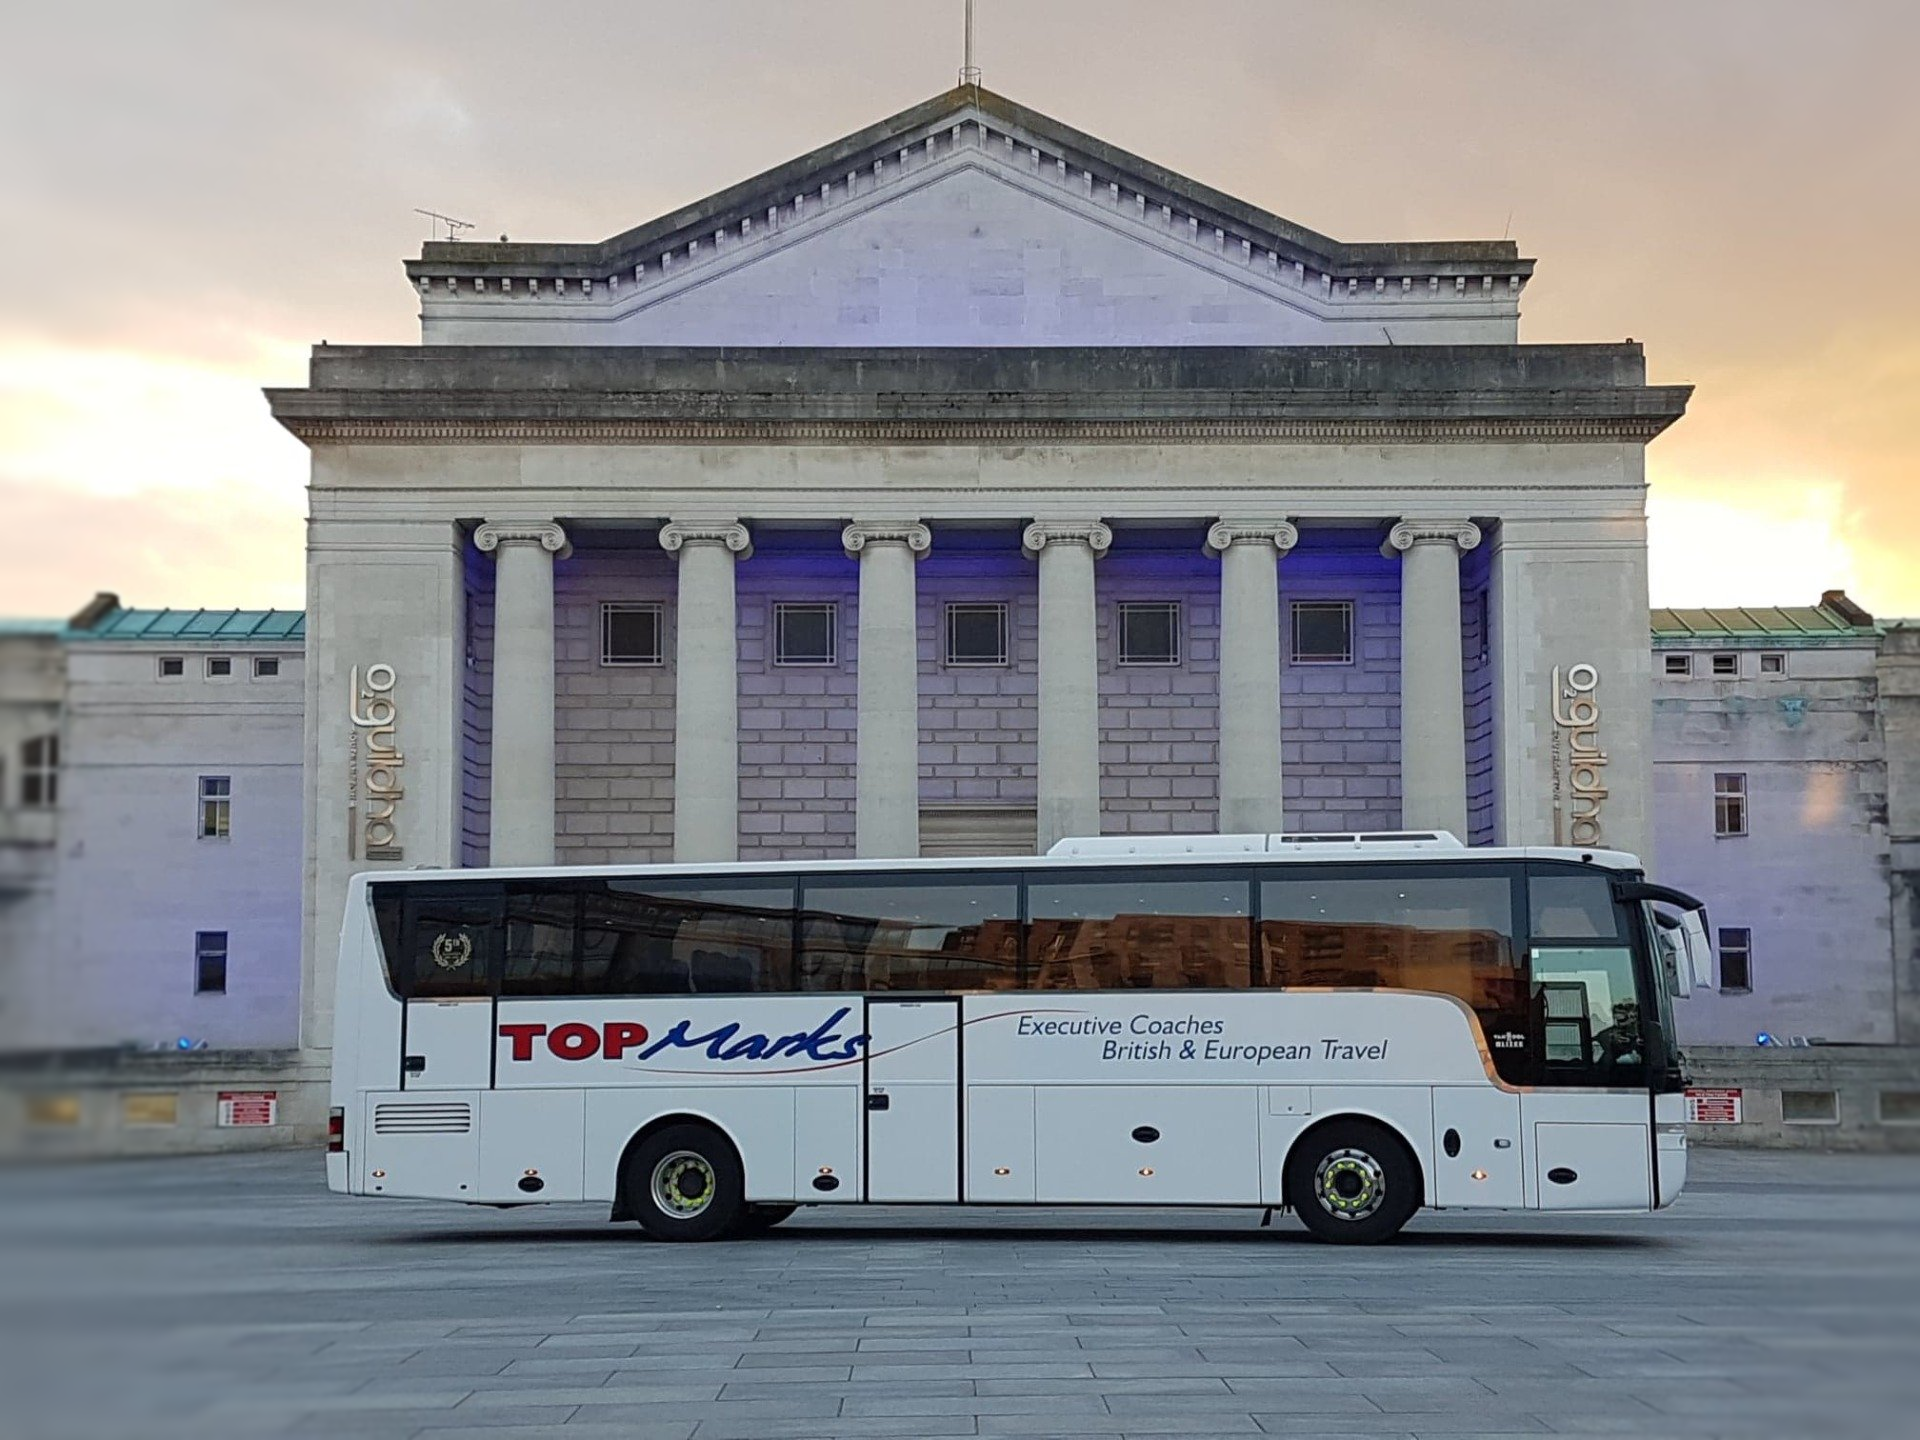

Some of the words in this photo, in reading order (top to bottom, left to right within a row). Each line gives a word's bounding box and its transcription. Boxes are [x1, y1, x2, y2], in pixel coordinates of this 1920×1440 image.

[1552, 664, 1609, 849] guildha
[499, 1022, 649, 1061] TOP
[637, 1006, 872, 1061] Marks
[1017, 1015, 1122, 1036] Executive
[1129, 1014, 1224, 1036] Coaches
[1102, 1039, 1172, 1061] British
[1179, 1040, 1197, 1061] &
[1203, 1040, 1312, 1065] European
[1320, 1039, 1389, 1061] Travel
